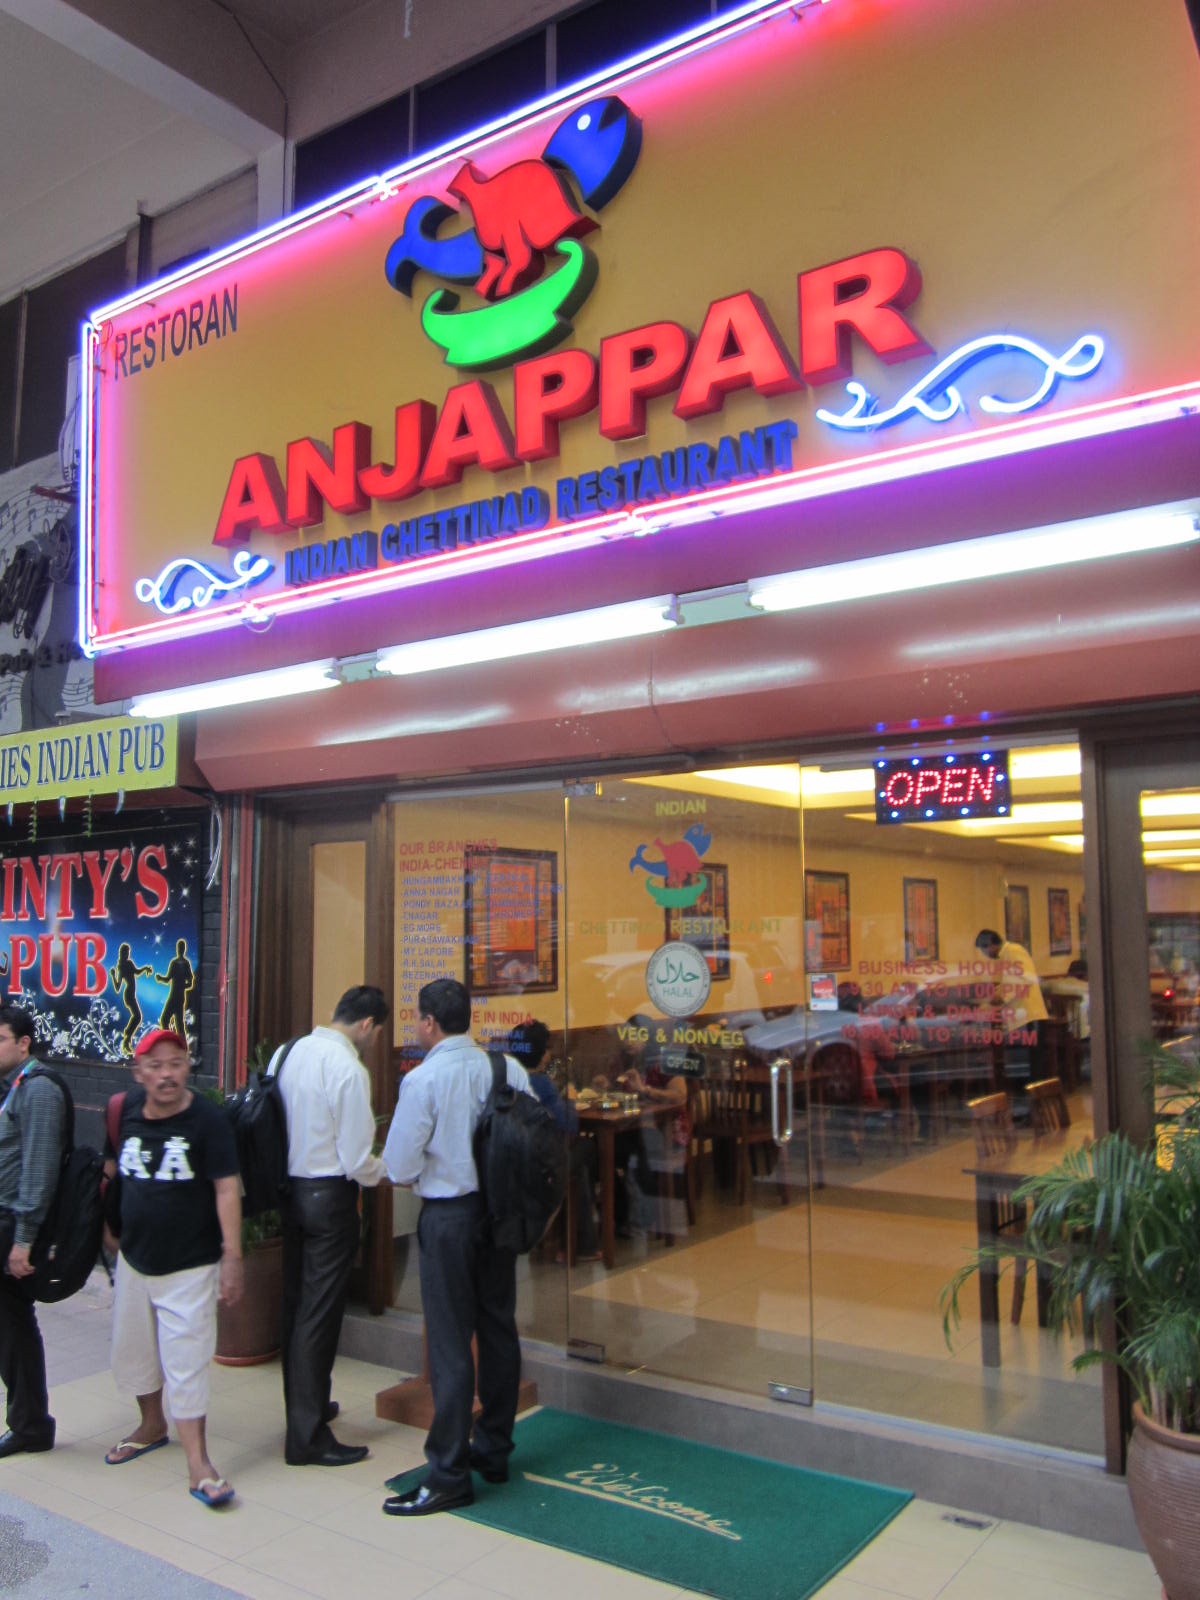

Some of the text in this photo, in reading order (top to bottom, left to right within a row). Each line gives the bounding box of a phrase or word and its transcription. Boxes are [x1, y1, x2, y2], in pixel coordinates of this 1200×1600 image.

[114, 283, 238, 380] RESTORAN
[212, 246, 935, 547] ANJAPPAR
[284, 418, 798, 587] INDIAN CHETTINAD RESTAURANT
[0, 722, 165, 789] IES INDIAN PUB
[886, 766, 995, 806] OPEN
[656, 800, 707, 816] INDIAN
[400, 838, 498, 856] OUR BRANCHES
[1, 844, 169, 922] INTY'S
[671, 918, 783, 935] RESTAURANT
[8, 932, 108, 998] PUB
[656, 957, 700, 985] حلال
[858, 960, 1024, 976] BUSINESS HOURS
[663, 987, 695, 997] HALAL
[923, 982, 948, 997] TO
[1002, 984, 1030, 999] PM
[500, 1011, 534, 1025] INDIA
[923, 1005, 936, 1019] &
[947, 1004, 1016, 1023] DINNER
[617, 1026, 745, 1046] VEG & NONVEG
[926, 1026, 950, 1042] TO
[1009, 1029, 1038, 1046] PM
[666, 1056, 700, 1070] OPEN
[564, 1463, 741, 1539] Welcome
